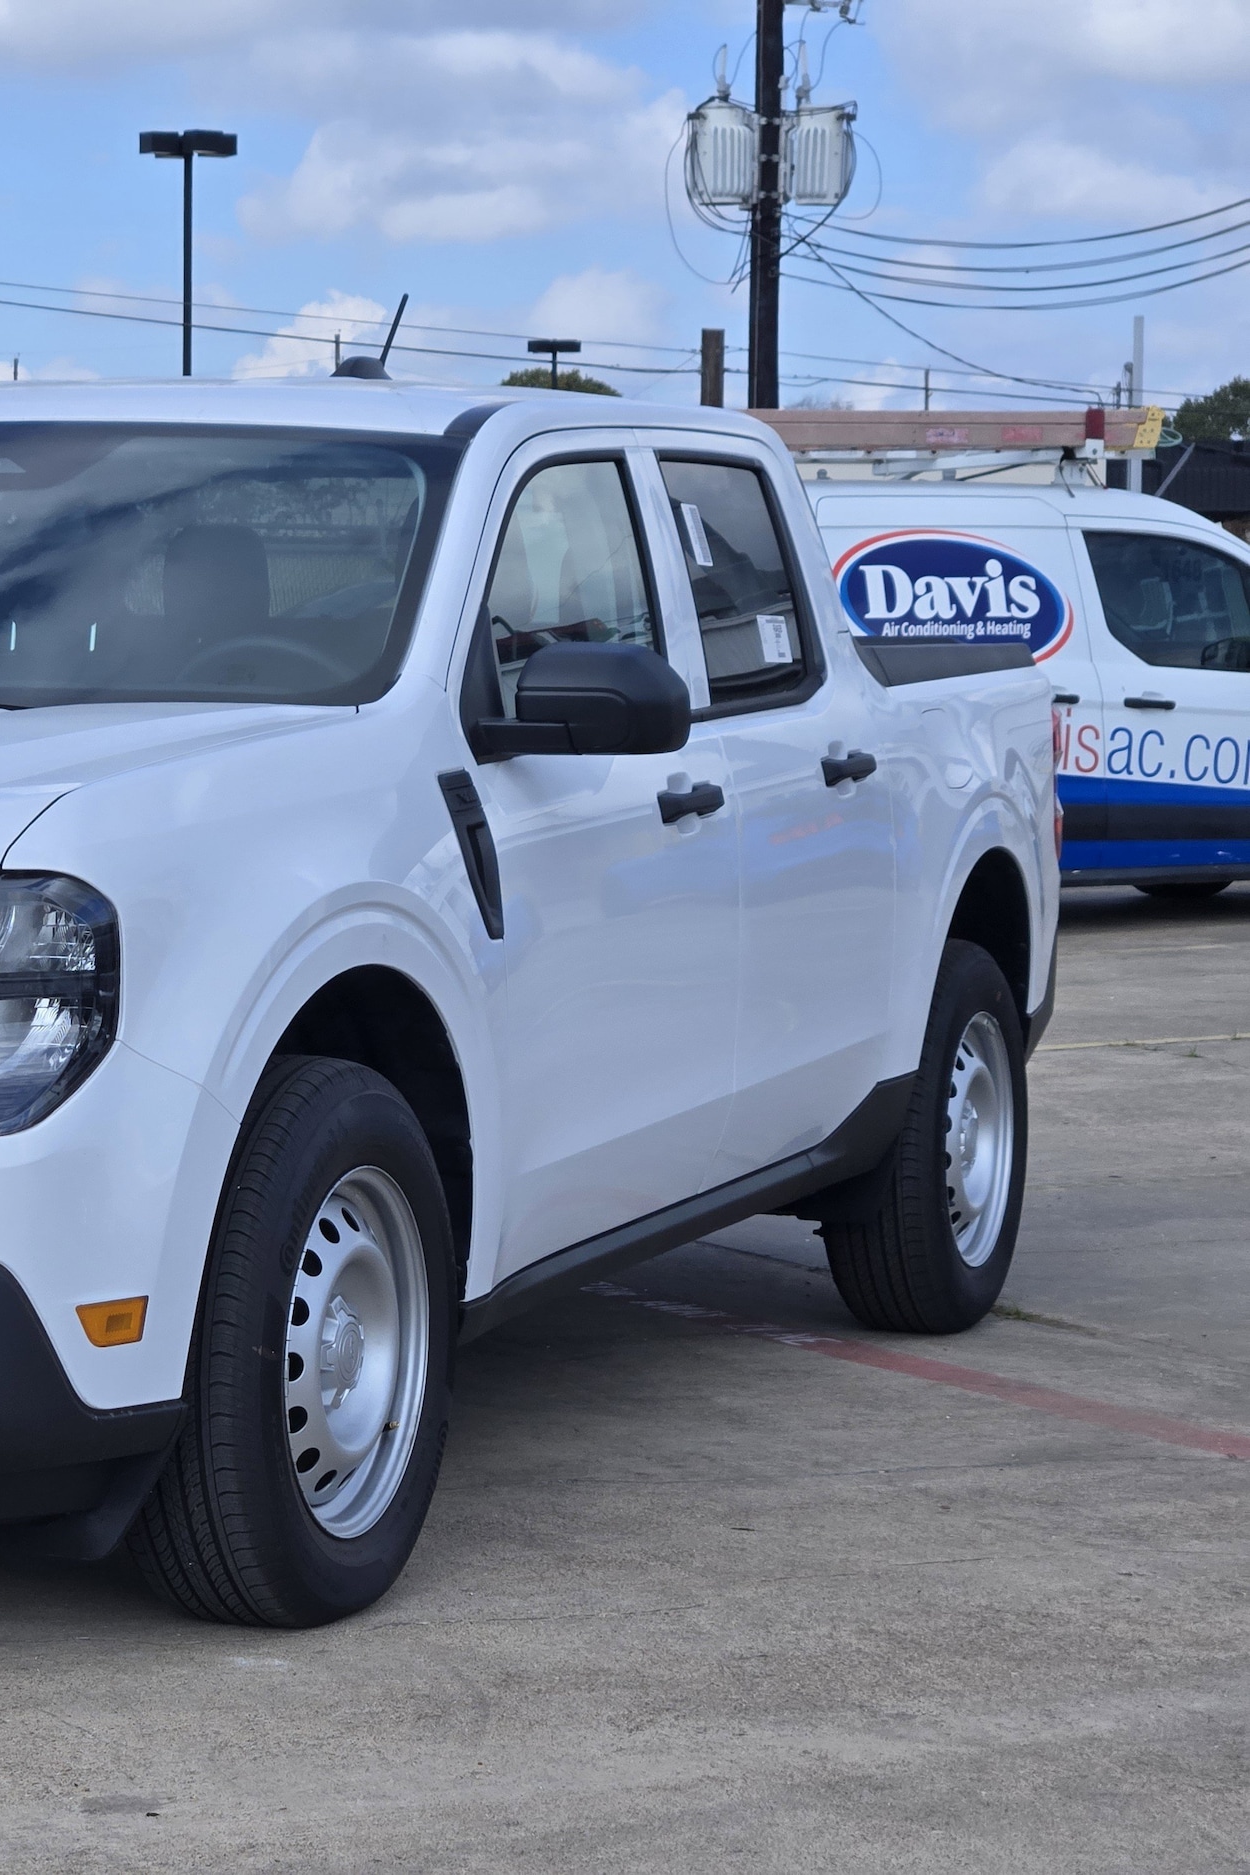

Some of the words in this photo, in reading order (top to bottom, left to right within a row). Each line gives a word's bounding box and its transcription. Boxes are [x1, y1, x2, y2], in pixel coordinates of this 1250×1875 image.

[858, 559, 1041, 620] Davis
[882, 621, 900, 637] Air
[901, 621, 975, 640] Conditioning
[976, 622, 986, 636] &
[987, 620, 1031, 639] Heating
[1062, 707, 1250, 785] isac.co
